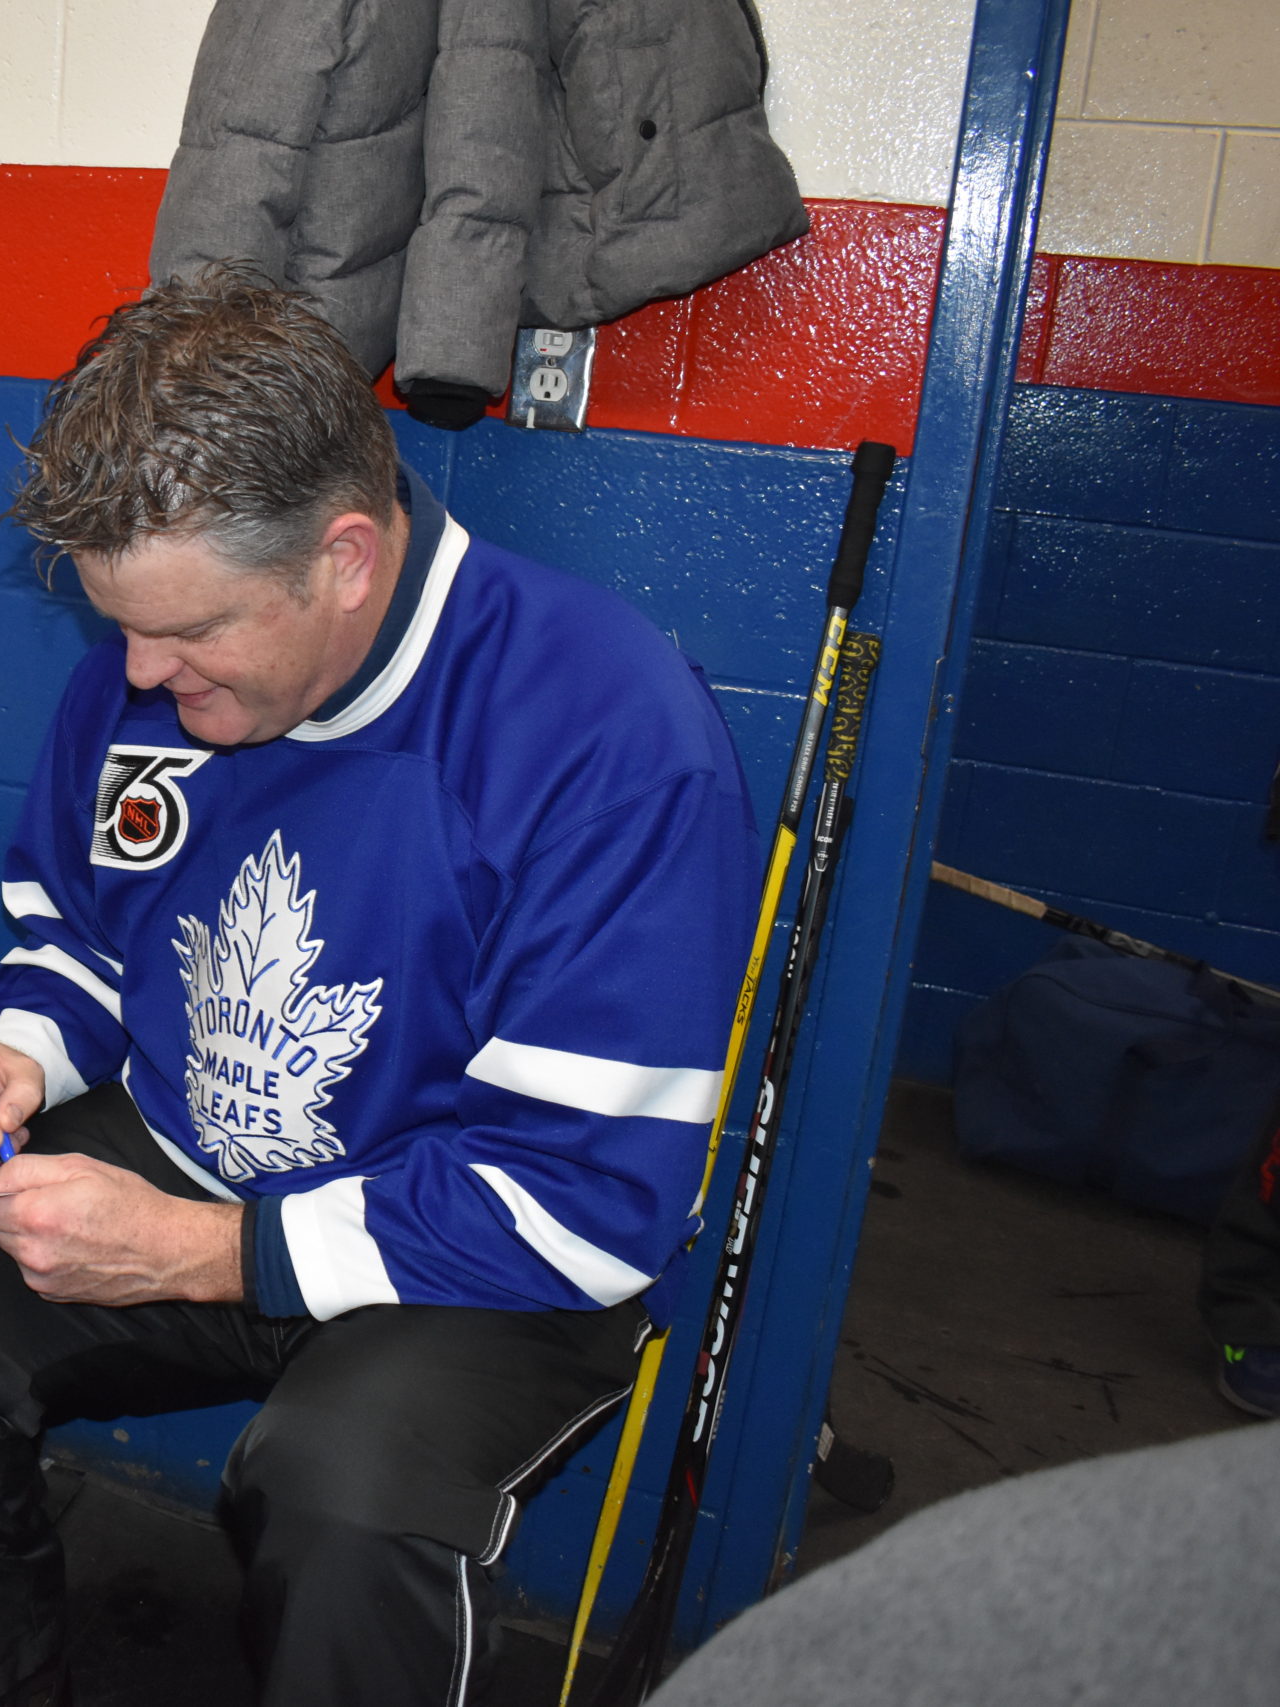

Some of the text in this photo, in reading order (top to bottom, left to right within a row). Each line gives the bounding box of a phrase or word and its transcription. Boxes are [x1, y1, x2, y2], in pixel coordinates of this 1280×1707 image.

[813, 615, 848, 707] CCM
[801, 755, 809, 772] GRIP
[805, 741, 813, 755] FLEX
[92, 752, 194, 863] 75
[793, 774, 804, 801] CROSBY
[126, 804, 152, 836] NHL
[736, 973, 757, 1025] TACKS
[194, 996, 317, 1078] TORONTO
[204, 1047, 280, 1099] MAPLE
[201, 1084, 283, 1135] LEAFS
